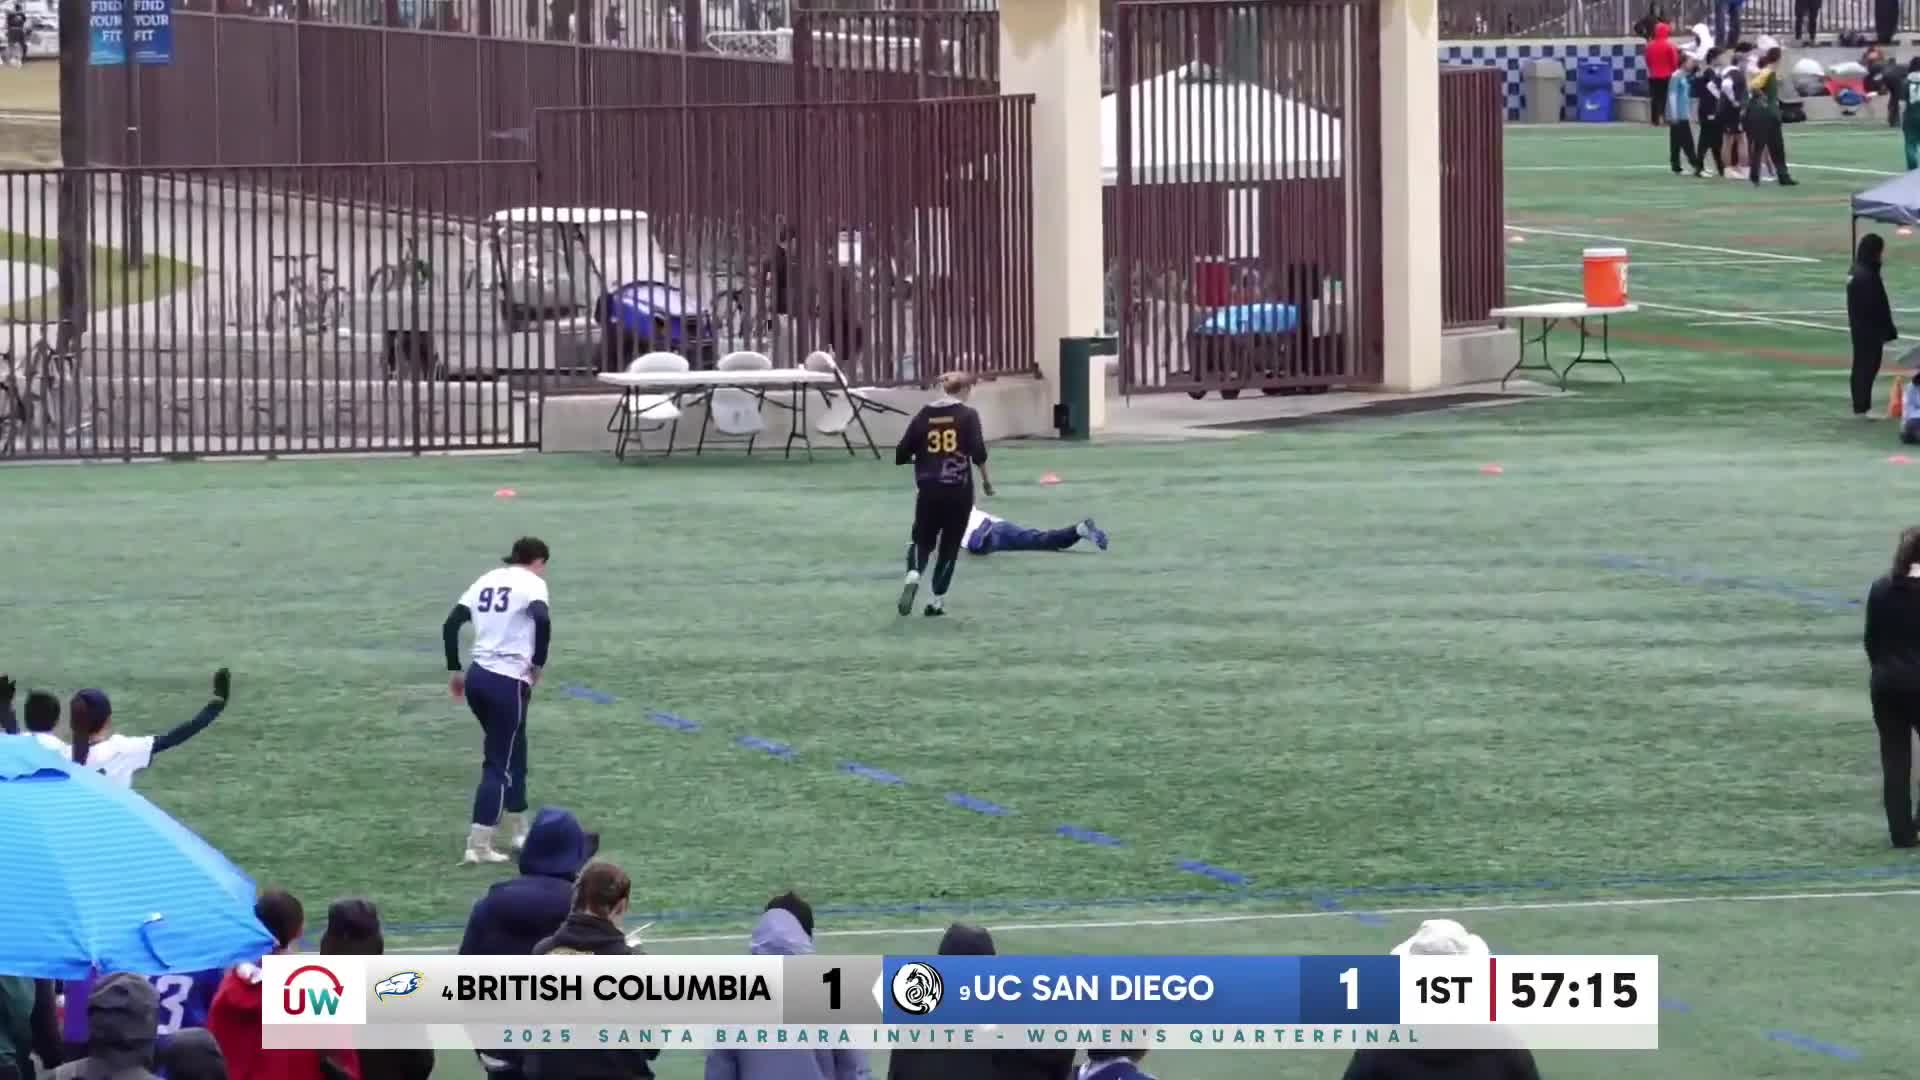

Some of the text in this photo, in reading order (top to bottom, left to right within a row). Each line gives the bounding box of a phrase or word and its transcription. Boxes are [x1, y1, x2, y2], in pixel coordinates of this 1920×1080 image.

[133, 0, 165, 11] FIND
[134, 15, 169, 26] YOUR
[102, 30, 122, 41] FIT
[134, 30, 154, 41] FIT
[927, 429, 957, 453] 38
[477, 586, 512, 613] 93
